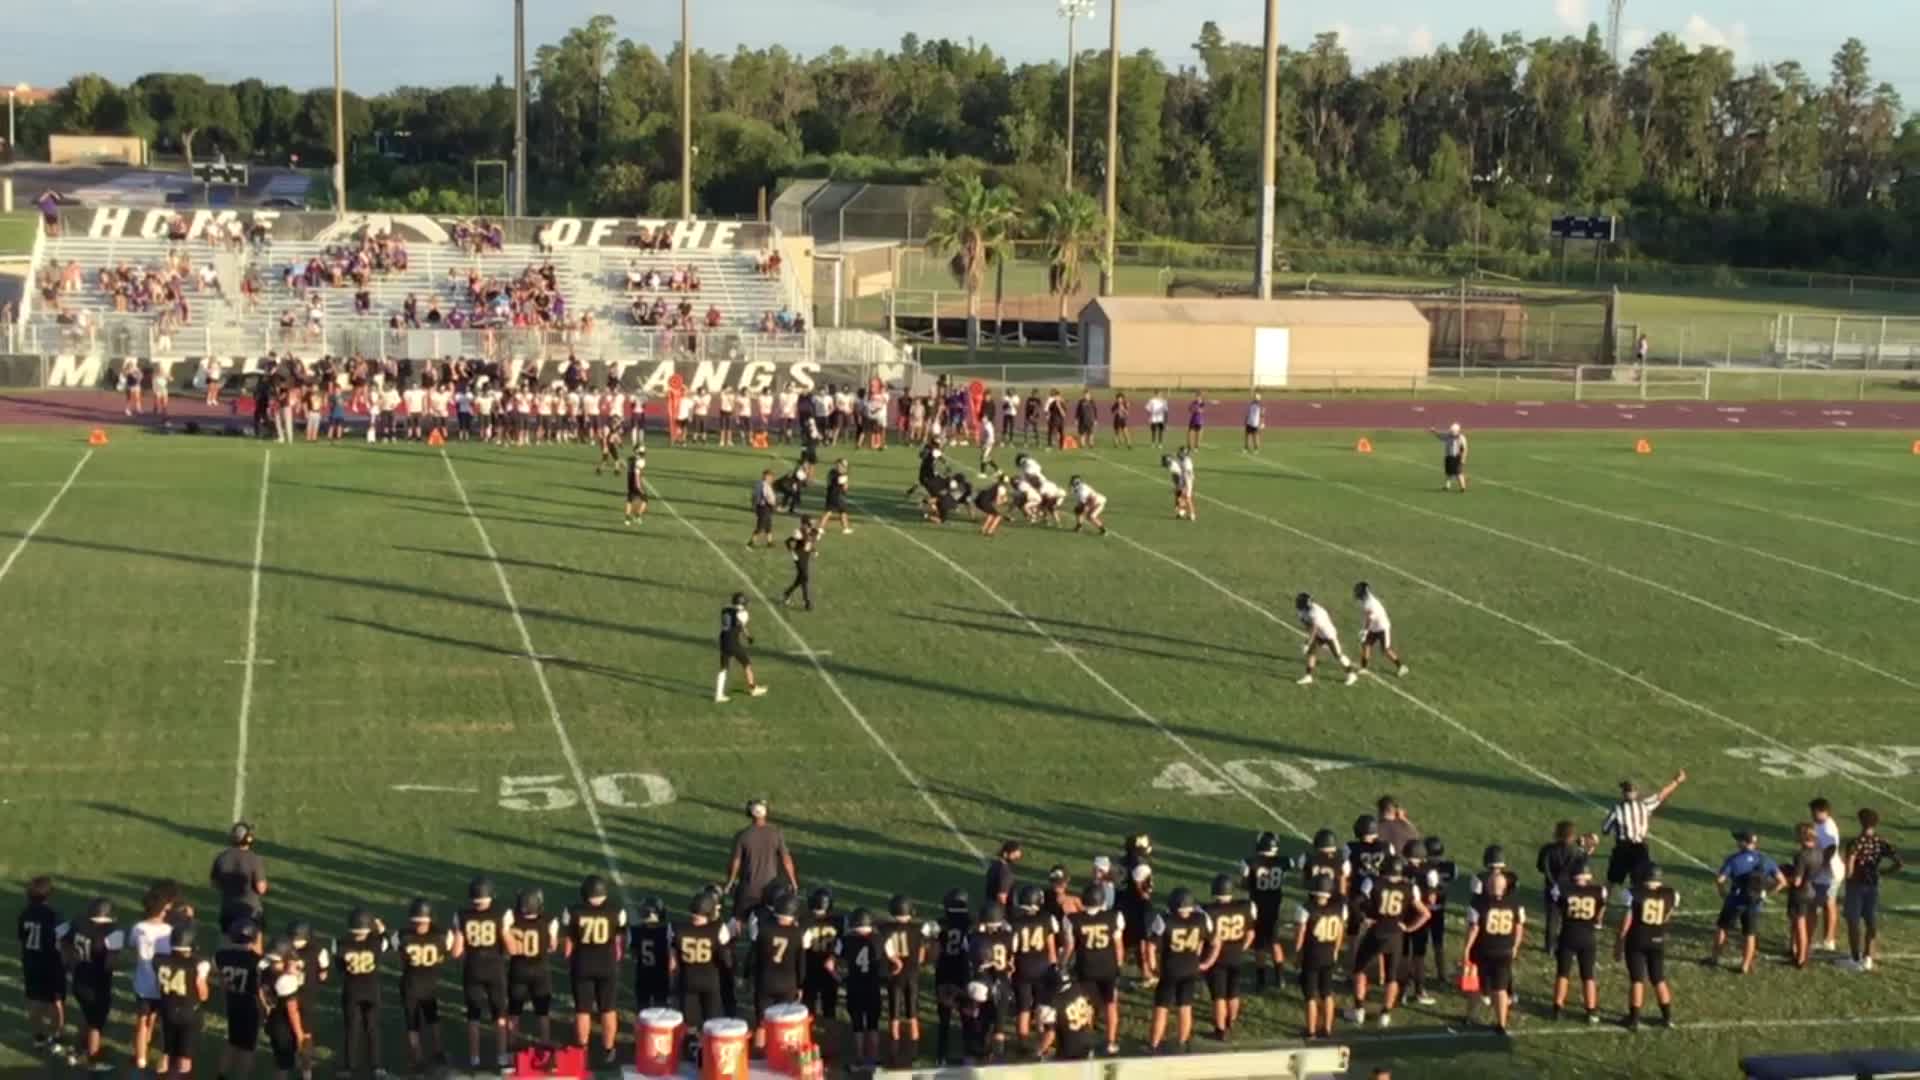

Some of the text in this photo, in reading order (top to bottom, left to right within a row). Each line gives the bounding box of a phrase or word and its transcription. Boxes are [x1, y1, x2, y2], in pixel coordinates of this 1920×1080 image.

[550, 218, 619, 246] OF
[637, 220, 742, 249] THE
[1722, 745, 1911, 778] 30
[1152, 759, 1318, 795] 40
[498, 772, 678, 811] 50
[1380, 889, 1403, 916] 16
[1642, 898, 1665, 925] 61
[580, 916, 609, 943] 70
[1021, 926, 1045, 952] 14
[1082, 923, 1110, 949] 75
[1171, 927, 1200, 953] 54
[1216, 915, 1244, 941] 62
[1313, 917, 1339, 944] 40
[405, 944, 437, 968] 30
[681, 937, 711, 963] 56
[773, 937, 788, 963] 7
[855, 945, 870, 974] 4
